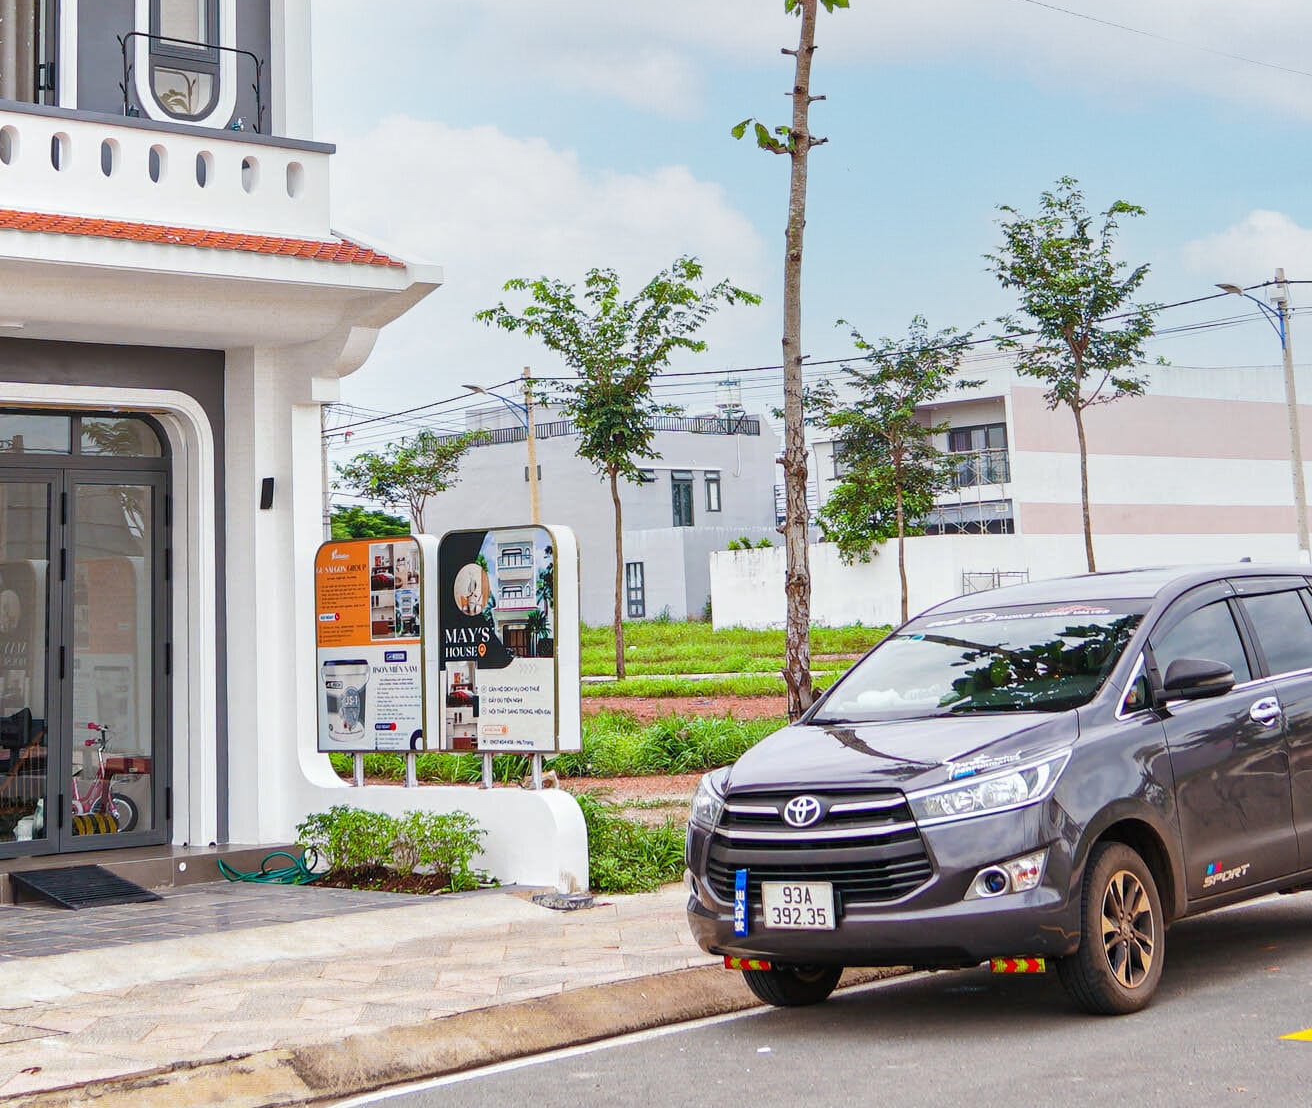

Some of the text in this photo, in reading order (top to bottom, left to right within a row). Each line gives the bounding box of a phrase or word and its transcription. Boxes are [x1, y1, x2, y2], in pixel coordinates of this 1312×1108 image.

[445, 645, 478, 658] HOUSE
[1203, 863, 1250, 888] SPORT
[782, 886, 813, 905] 93A
[772, 907, 826, 926] 392.35
